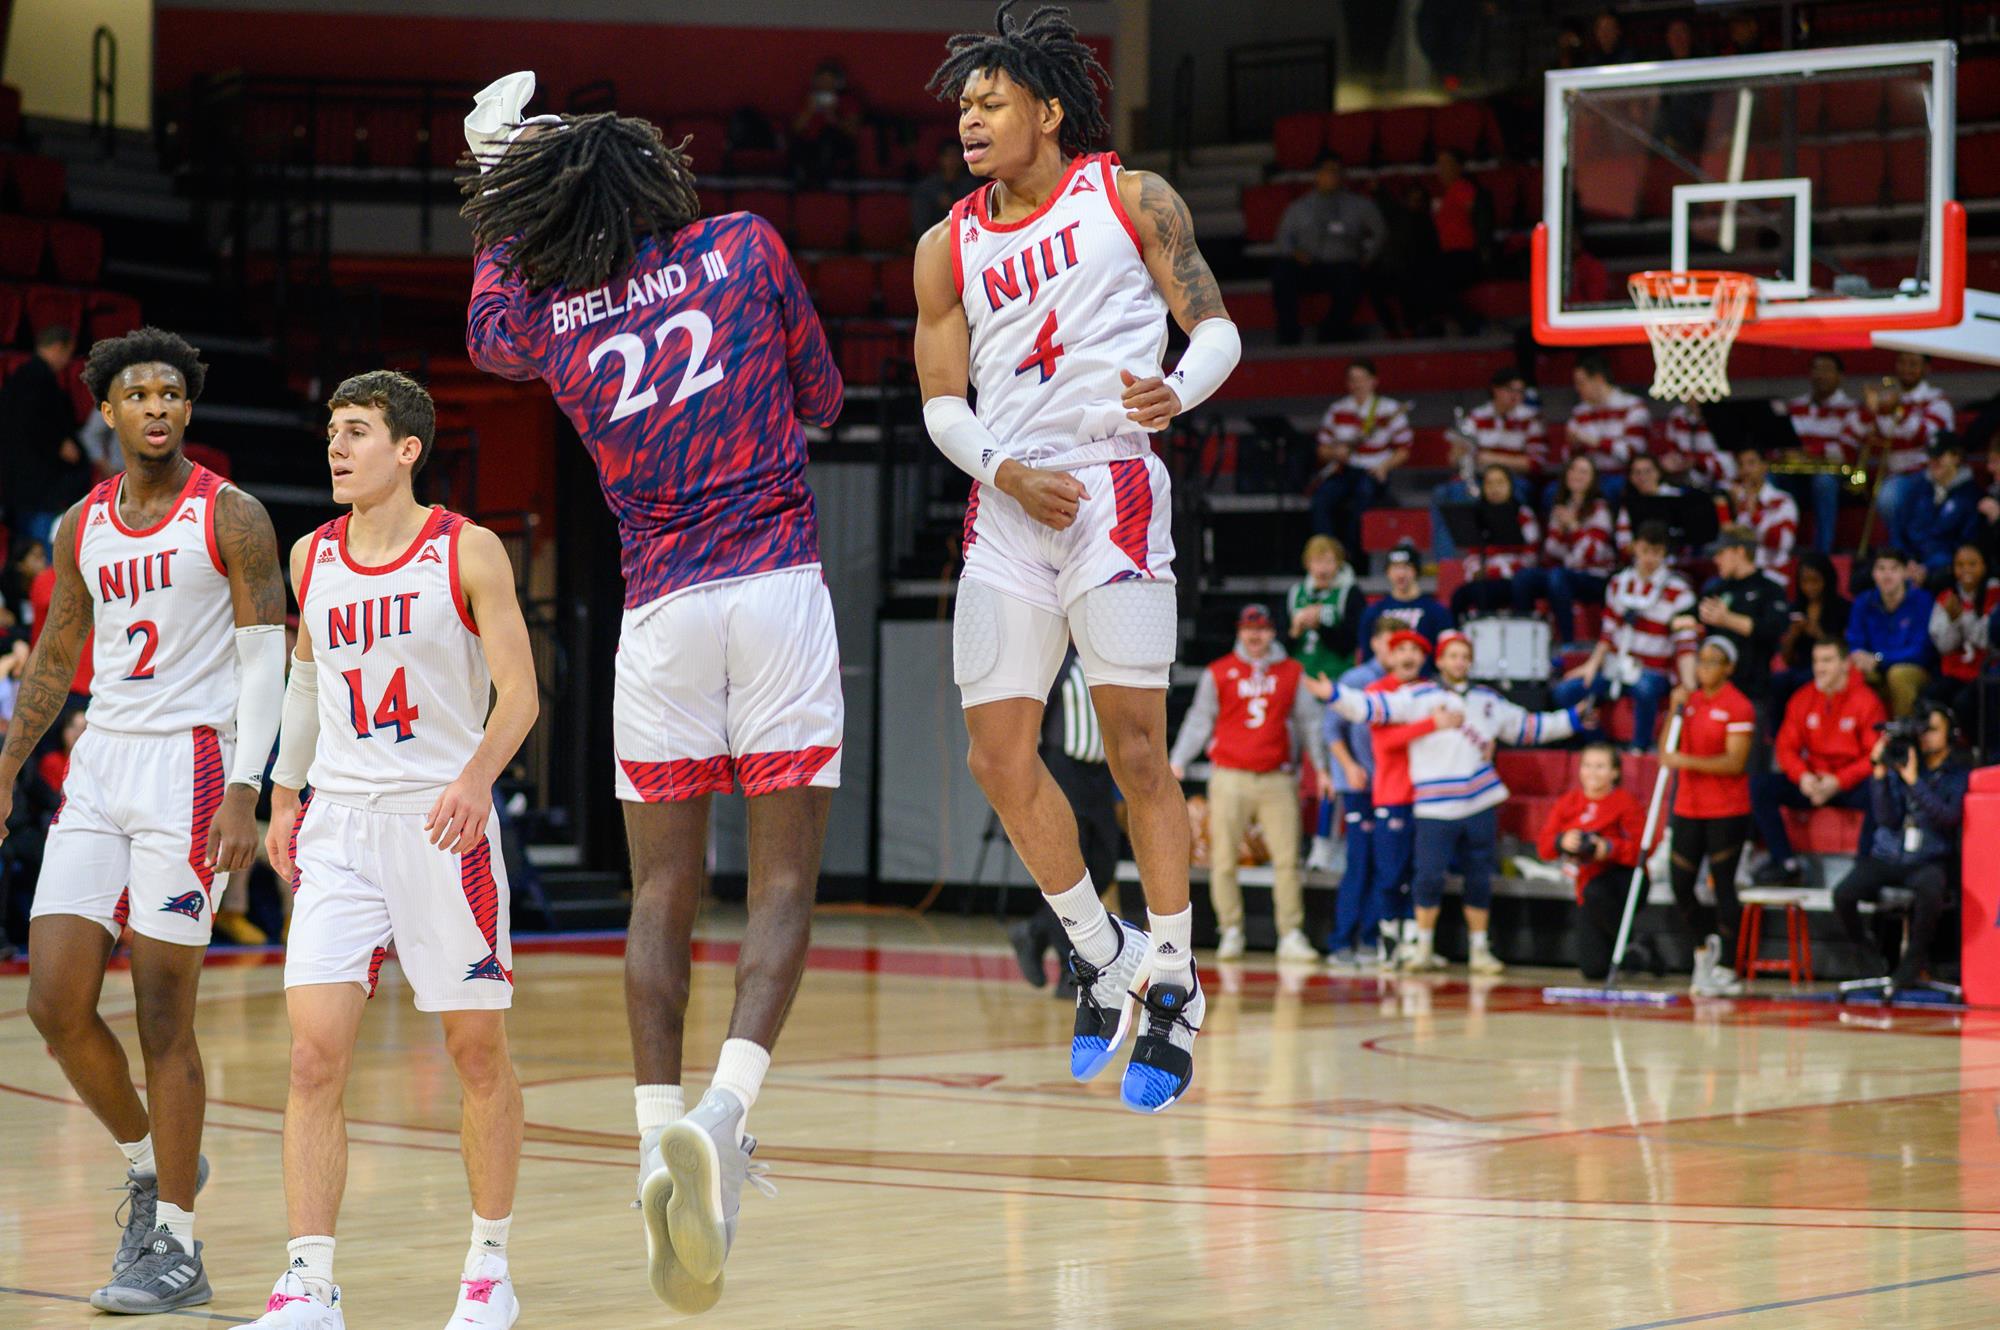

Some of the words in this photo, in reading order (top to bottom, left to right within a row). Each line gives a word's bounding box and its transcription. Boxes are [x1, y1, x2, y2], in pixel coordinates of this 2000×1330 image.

[552, 264, 687, 335] BRELAND
[701, 250, 728, 282] III
[982, 221, 1080, 313] NJIT
[588, 310, 725, 423] 22
[1015, 309, 1064, 385] 4
[98, 549, 177, 608] NJIT
[123, 620, 158, 681] 2
[328, 591, 420, 655] NJIT
[341, 667, 419, 743] 14
